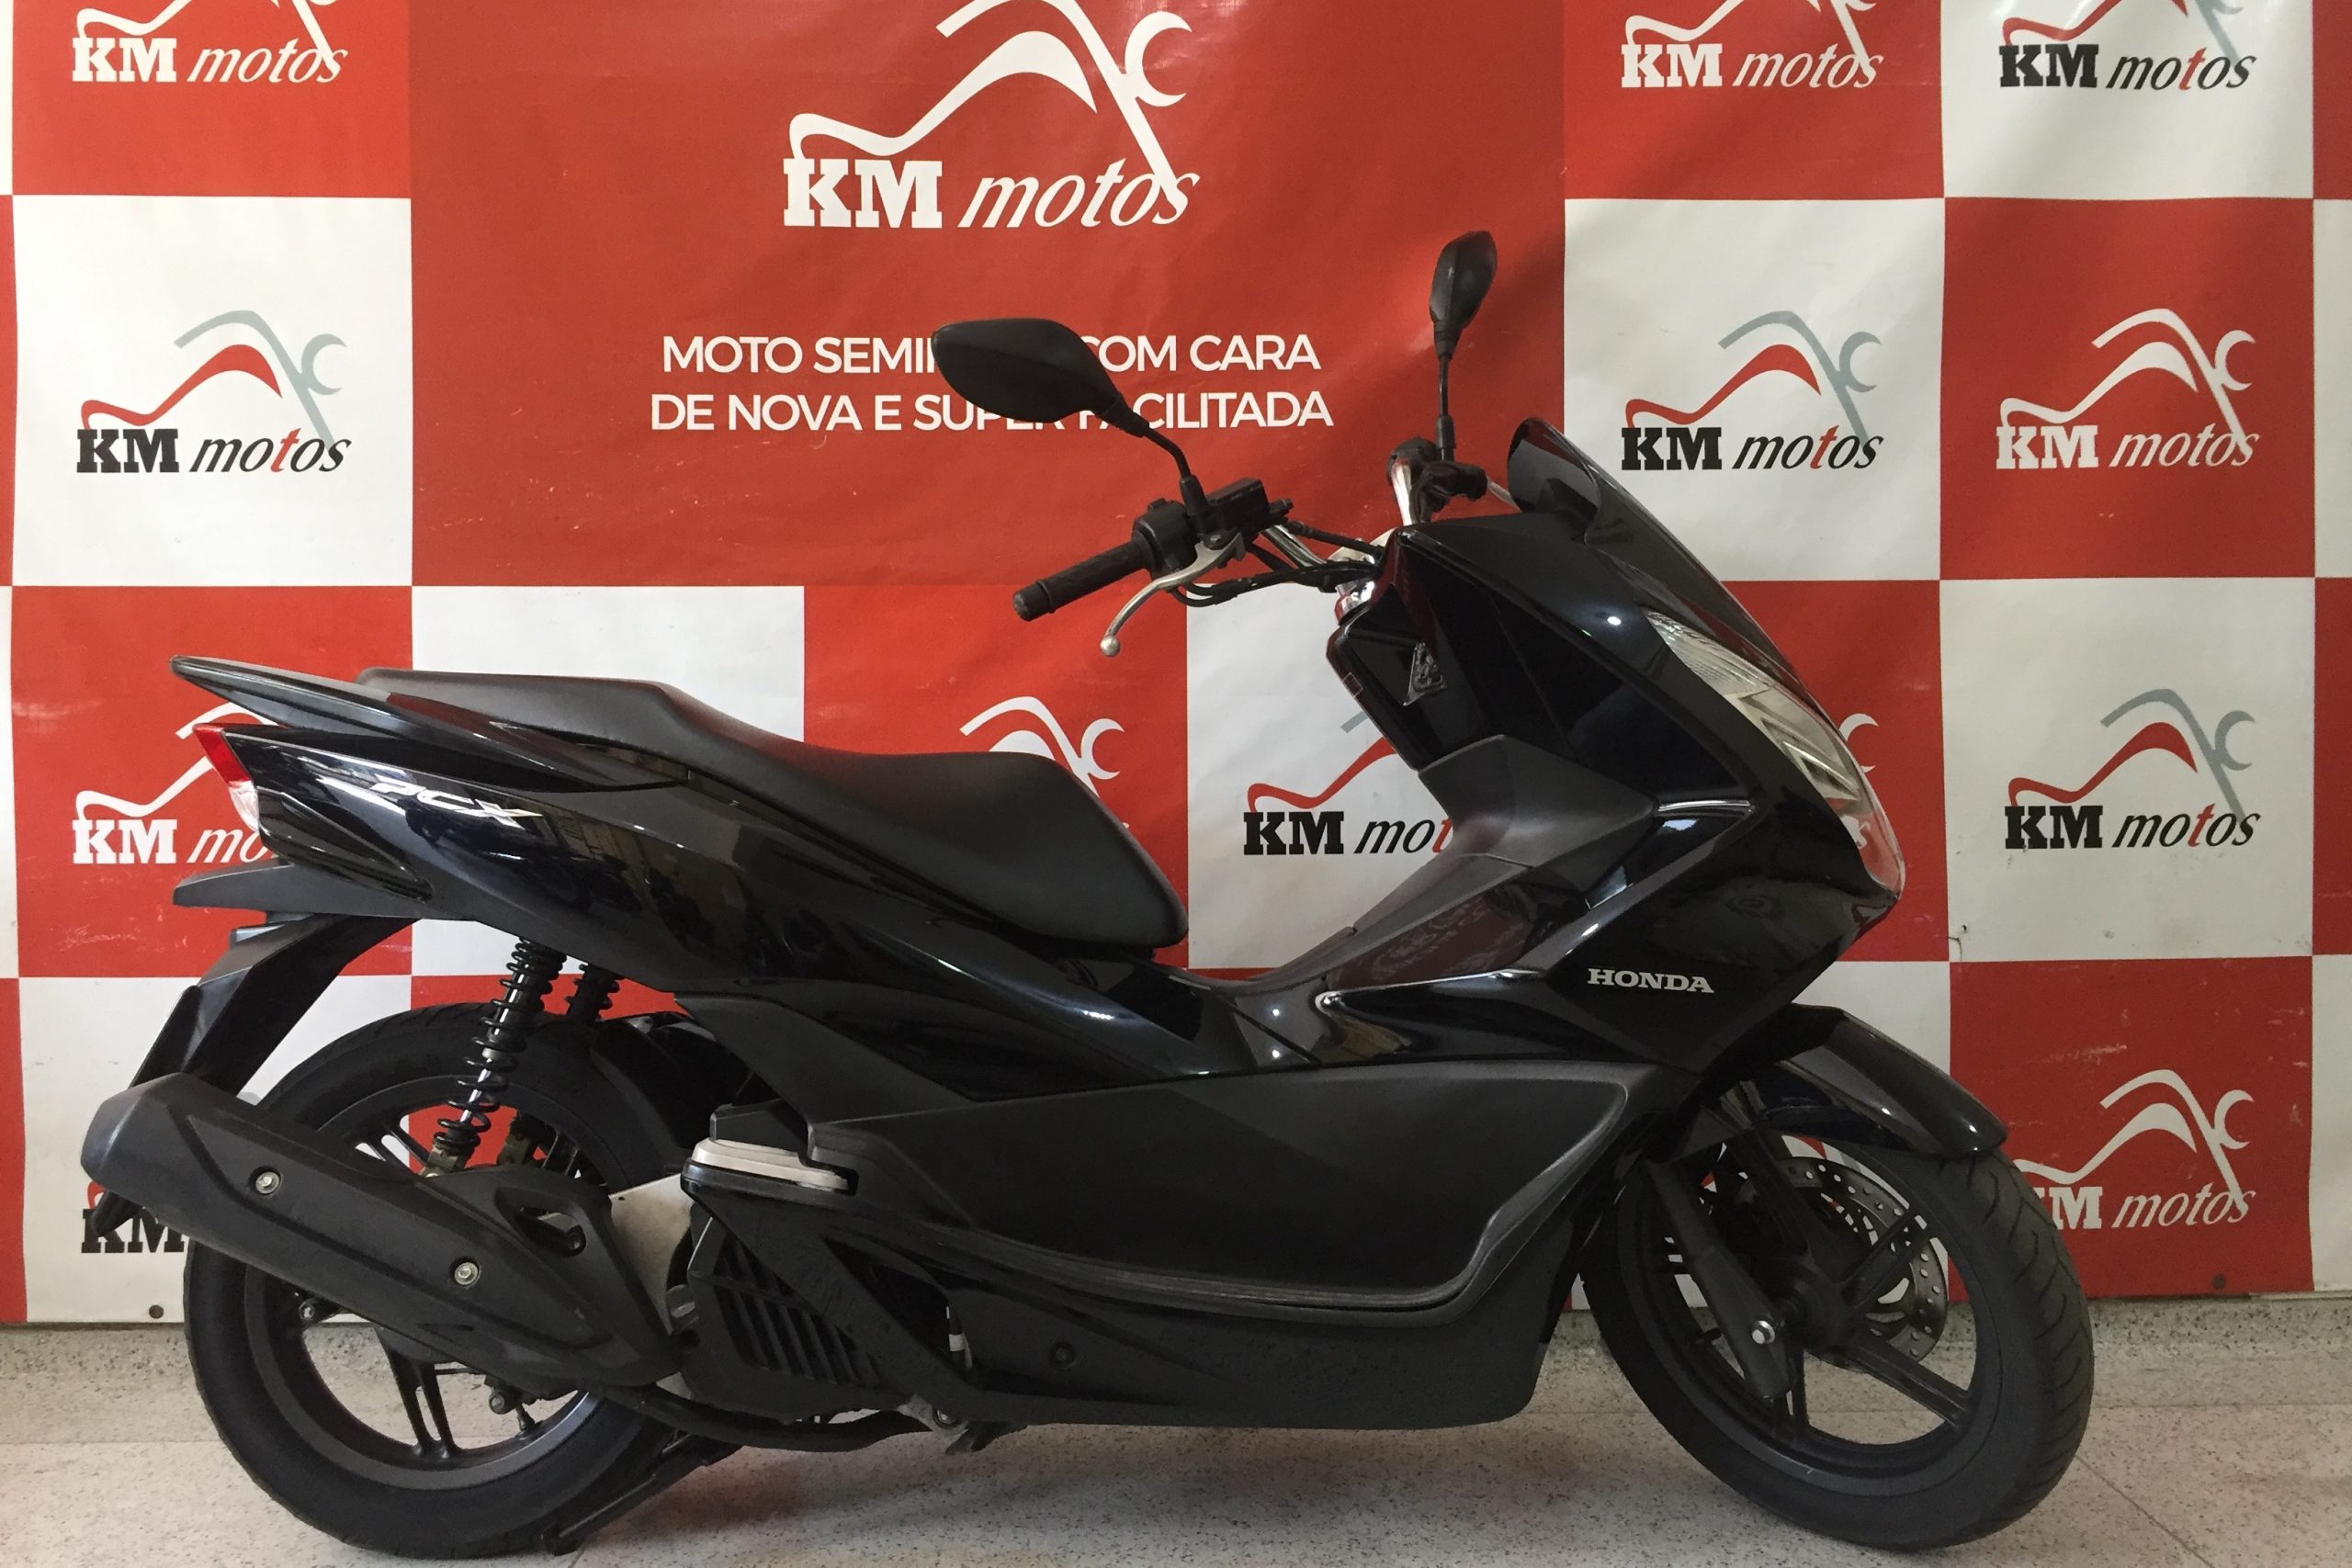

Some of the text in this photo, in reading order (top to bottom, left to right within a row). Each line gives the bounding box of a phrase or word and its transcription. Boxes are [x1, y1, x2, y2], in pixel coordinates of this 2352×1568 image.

[73, 38, 348, 83] KM motos
[1622, 42, 1883, 88] KM motos
[1999, 43, 2256, 91] KM motos
[783, 158, 1200, 228] KM motos
[662, 336, 802, 373] MOTO
[1190, 334, 1322, 371] CARA
[651, 394, 714, 431] DE
[729, 394, 863, 431] NOVA
[875, 395, 902, 431] E
[76, 428, 351, 474] KM motos
[1622, 425, 1883, 471] KM motos
[1996, 423, 2260, 469] KM motos
[369, 773, 543, 830] PCX
[73, 819, 177, 864] KM
[1244, 811, 1344, 855] KM
[2005, 803, 2262, 849] KM motos
[1588, 968, 1715, 994] HONDA
[2032, 1182, 2256, 1229] M motos
